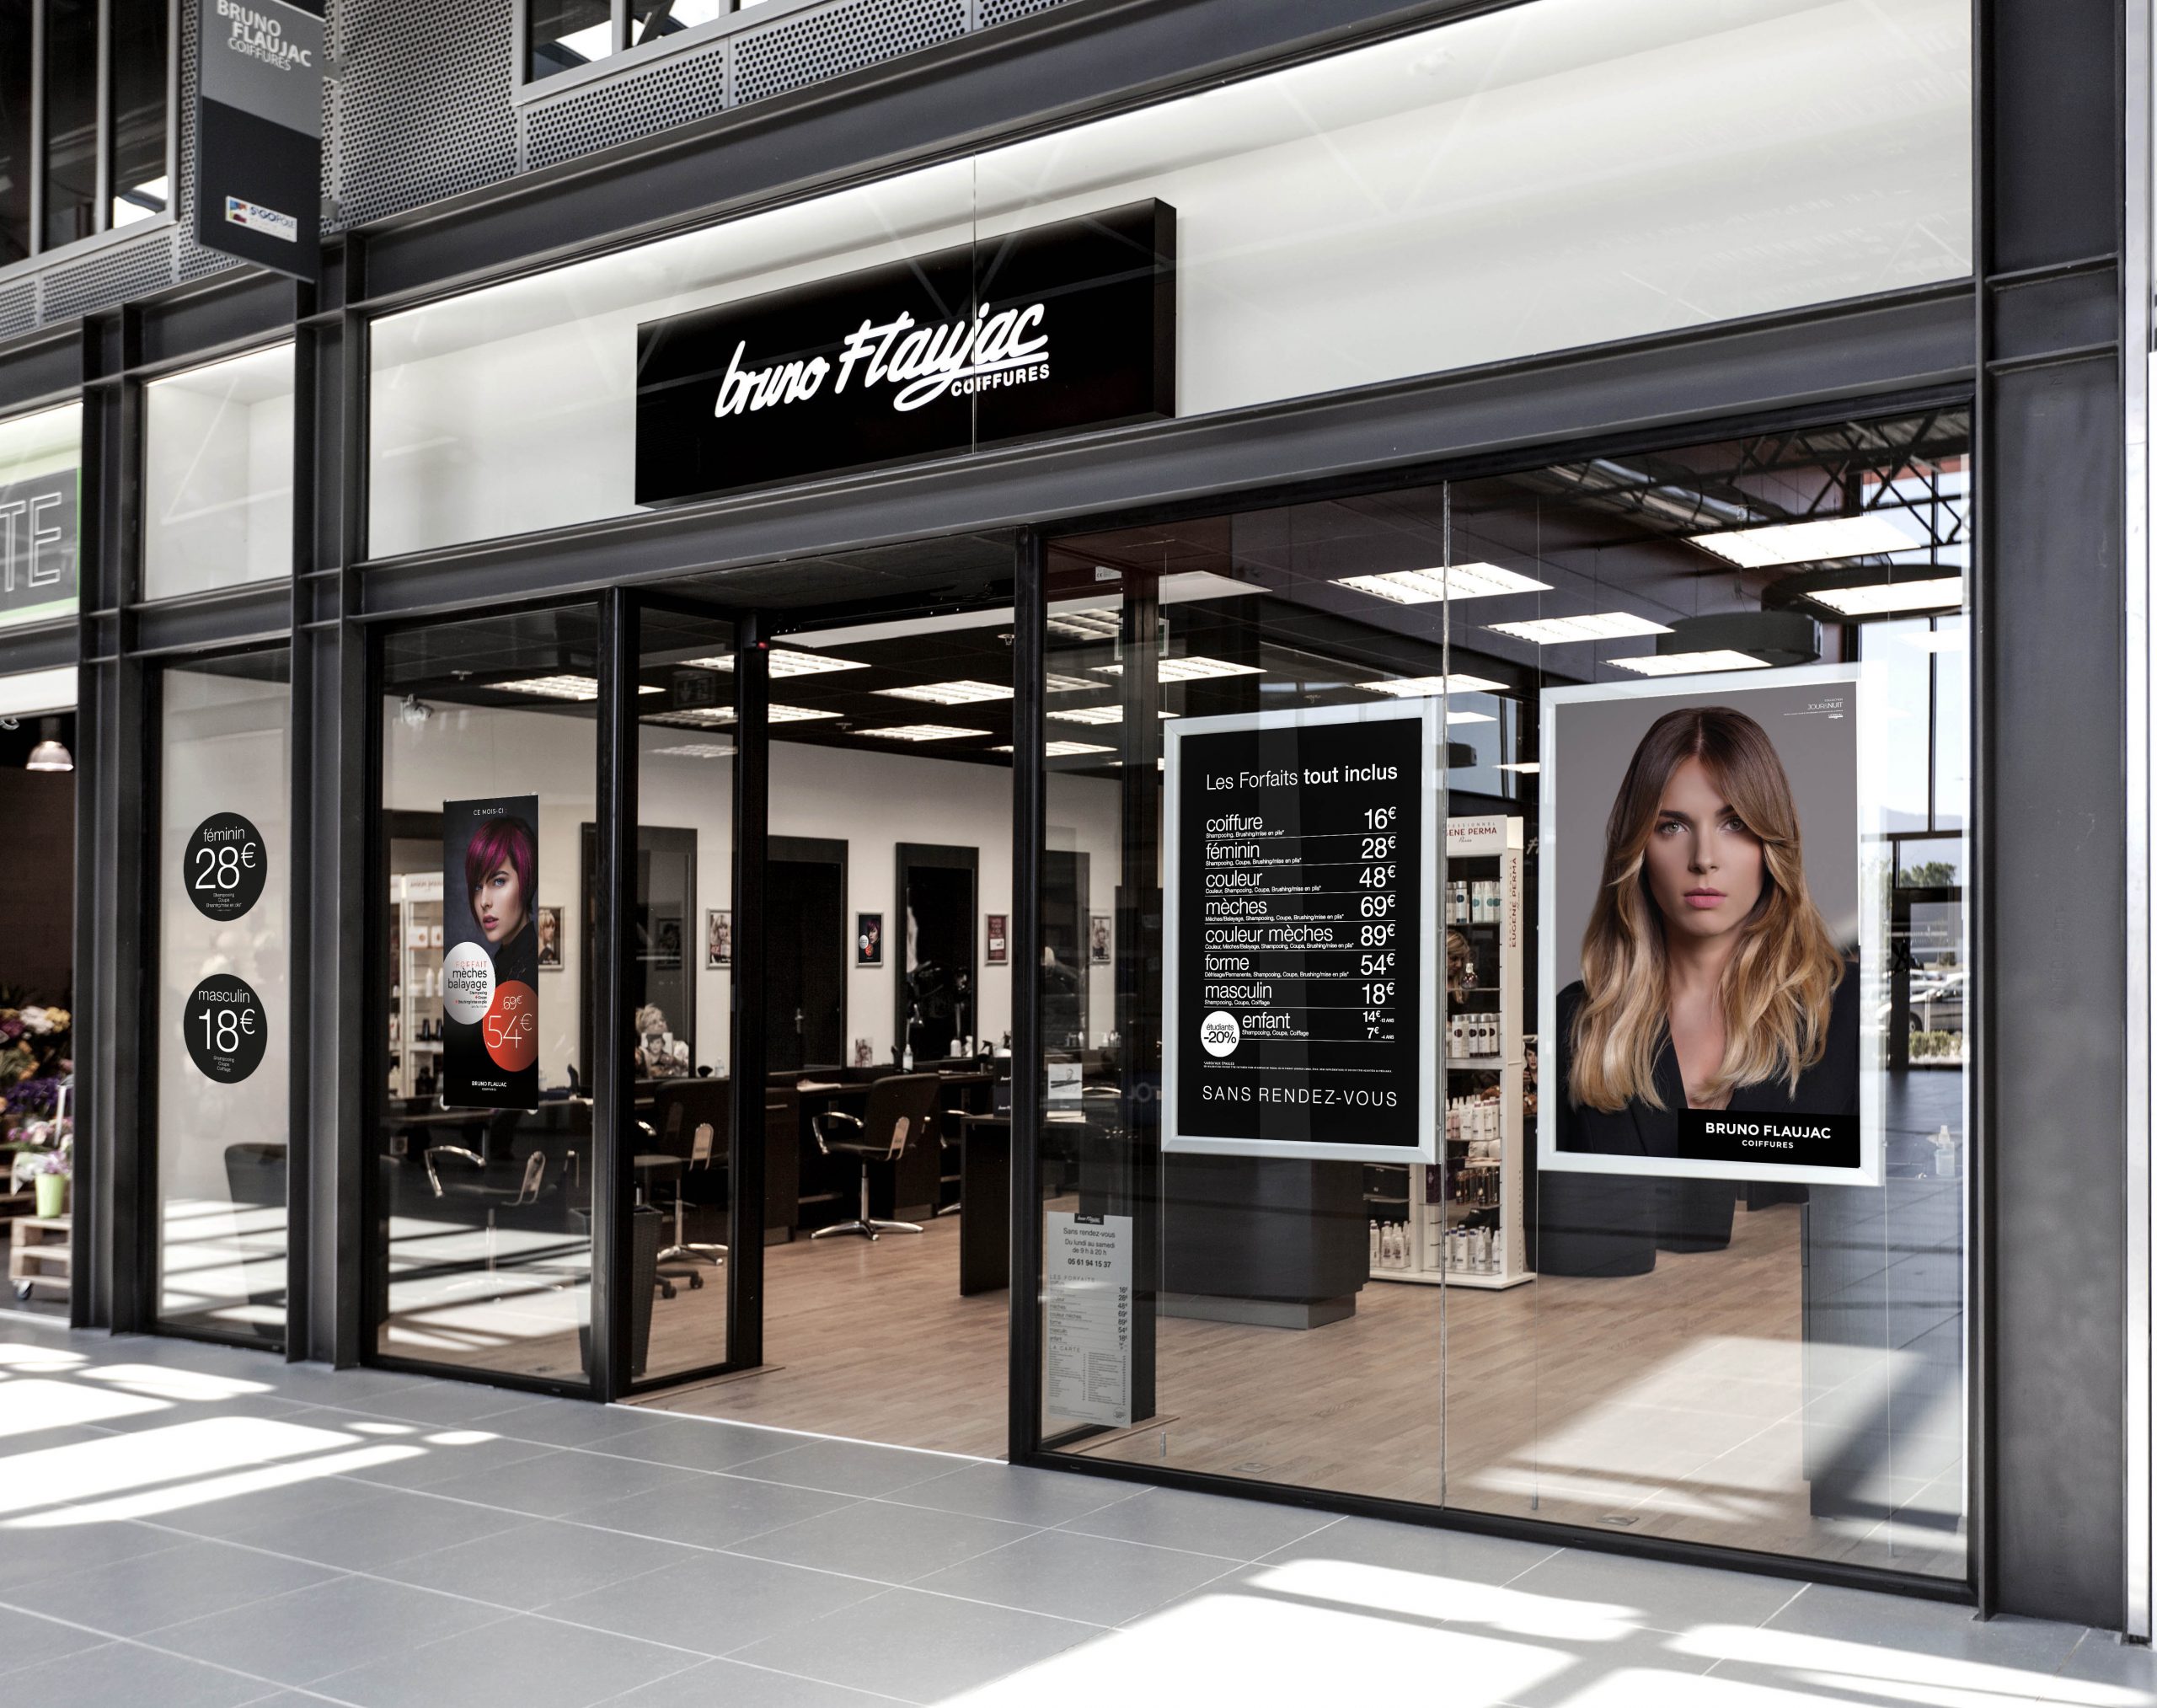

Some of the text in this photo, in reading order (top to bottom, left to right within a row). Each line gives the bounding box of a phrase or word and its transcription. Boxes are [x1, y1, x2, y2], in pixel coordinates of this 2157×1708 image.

[217, 0, 281, 37] BRUNO
[227, 37, 292, 71] COIFFURES
[232, 20, 312, 67] FLAUJAC
[715, 302, 1049, 418] bruno Flaujac
[950, 363, 1051, 397] COIFFURES
[0, 491, 62, 592] TE
[1207, 763, 1399, 790] Les Forfaits tout inclus
[1206, 806, 1397, 833] coiffure 16€
[1468, 827, 1497, 835] PERMA
[203, 827, 246, 843] féminin
[1206, 836, 1397, 859] féminin 28€
[195, 842, 256, 891] 28€
[1206, 865, 1396, 888] couleur 48€
[1206, 894, 1396, 918] mèches 69€
[1205, 924, 1395, 946] couleur mèches 89€
[452, 967, 488, 978] mèches
[1204, 953, 1395, 976] forme 54€
[198, 988, 250, 1004] masculin
[447, 978, 488, 991] balayage
[1205, 982, 1395, 1004] masculin 18€
[197, 1008, 256, 1053] 18€
[487, 1013, 533, 1049] 54€
[1242, 1011, 1291, 1029] enfant
[1362, 1010, 1381, 1022] 14€
[1203, 1031, 1237, 1044] -20%
[1367, 1026, 1379, 1039] 7€
[1202, 1085, 1398, 1107] SANS RENDEZ-VOUS
[1705, 1122, 1832, 1139] BRUNO FLAUJAC
[1742, 1139, 1794, 1148] COIFFURES
[1079, 1229, 1116, 1239] rendez-vous
